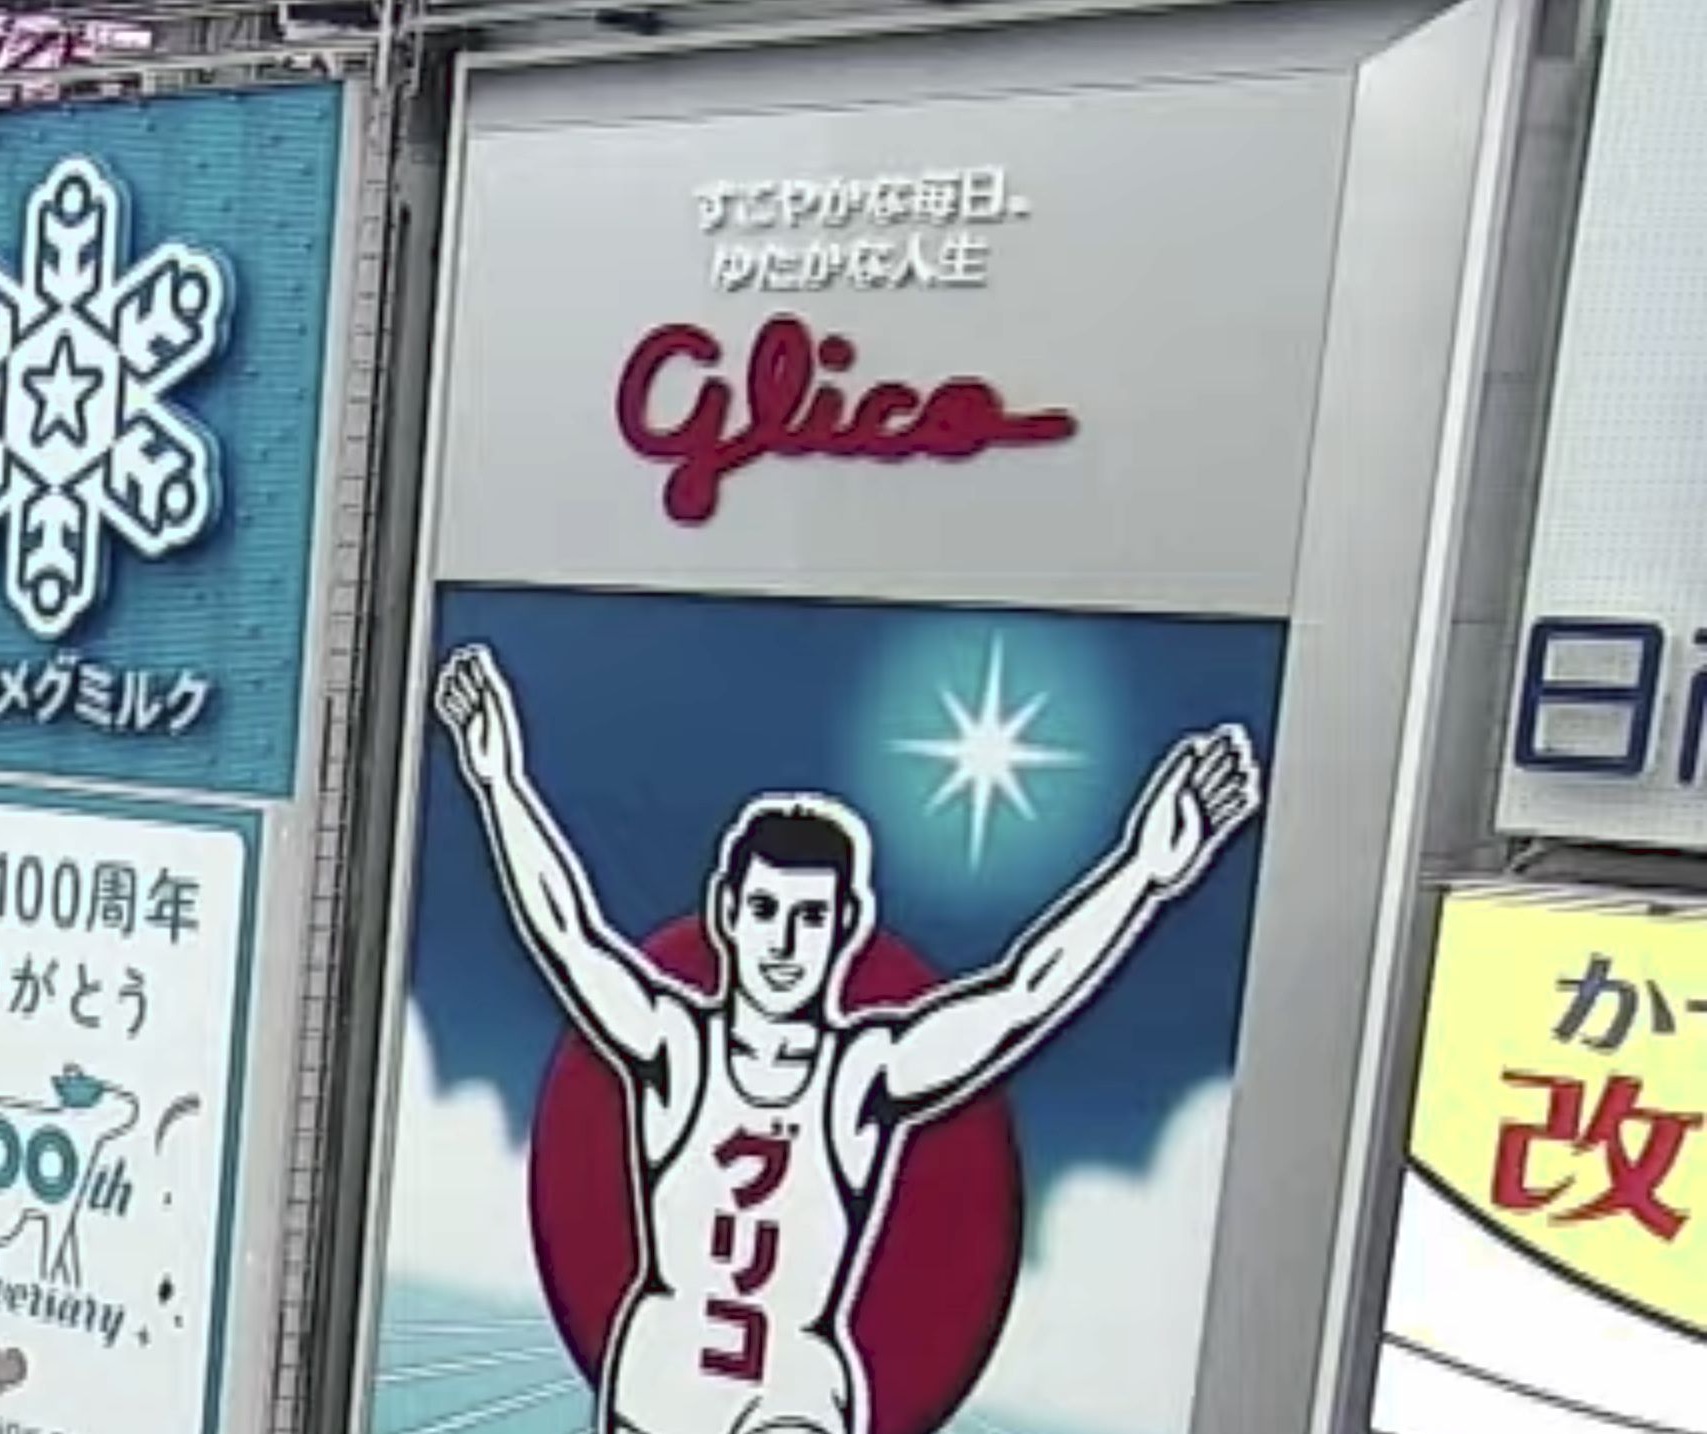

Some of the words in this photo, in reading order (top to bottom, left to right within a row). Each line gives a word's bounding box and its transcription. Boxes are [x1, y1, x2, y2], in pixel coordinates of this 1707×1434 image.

[709, 229, 989, 292] ゆたかな人生
[617, 312, 1077, 526] Glico
[699, 1118, 800, 1384] グリコ
